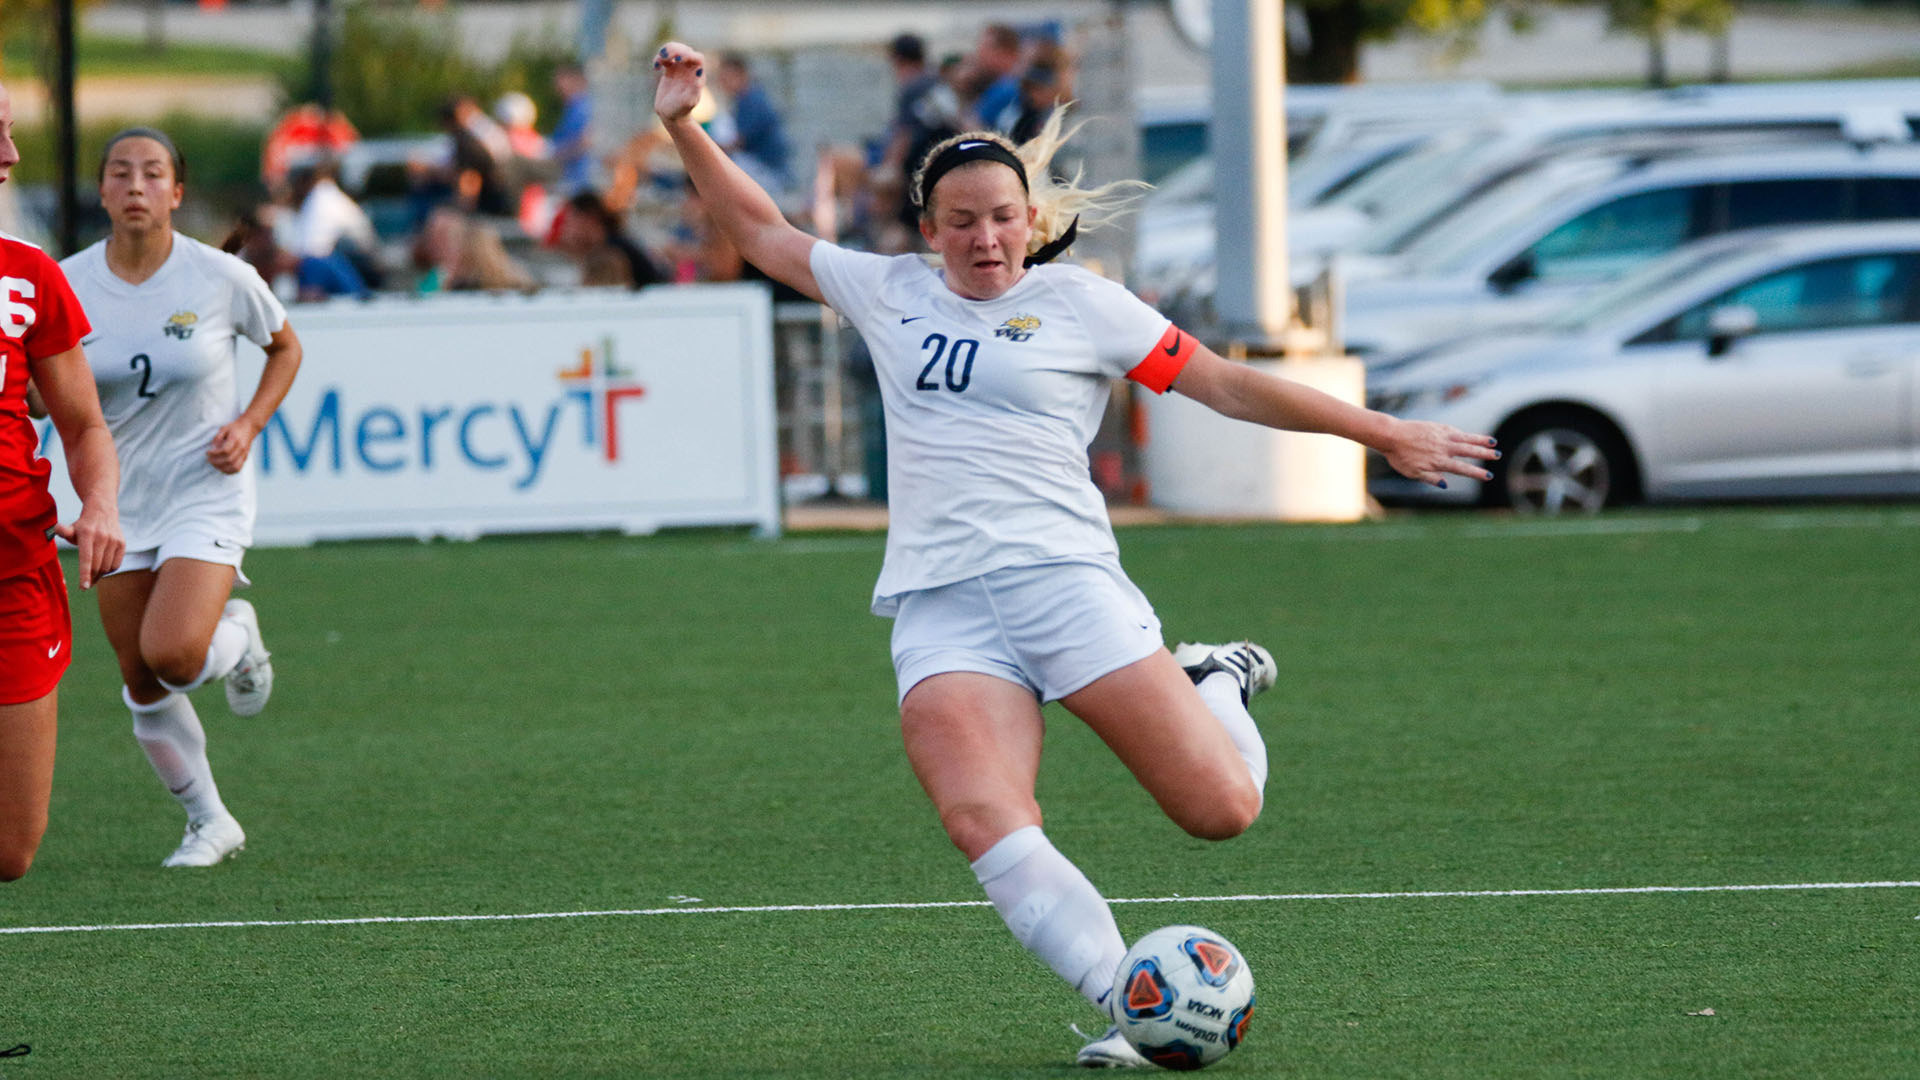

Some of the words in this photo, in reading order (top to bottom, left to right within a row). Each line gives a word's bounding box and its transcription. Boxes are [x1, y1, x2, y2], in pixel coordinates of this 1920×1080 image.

[0, 276, 36, 338] 6
[130, 353, 156, 398] 2
[916, 332, 980, 393] 20
[260, 388, 560, 491] Mercy
[1175, 1019, 1219, 1043] Wilson
[1187, 998, 1225, 1020] NCAA
